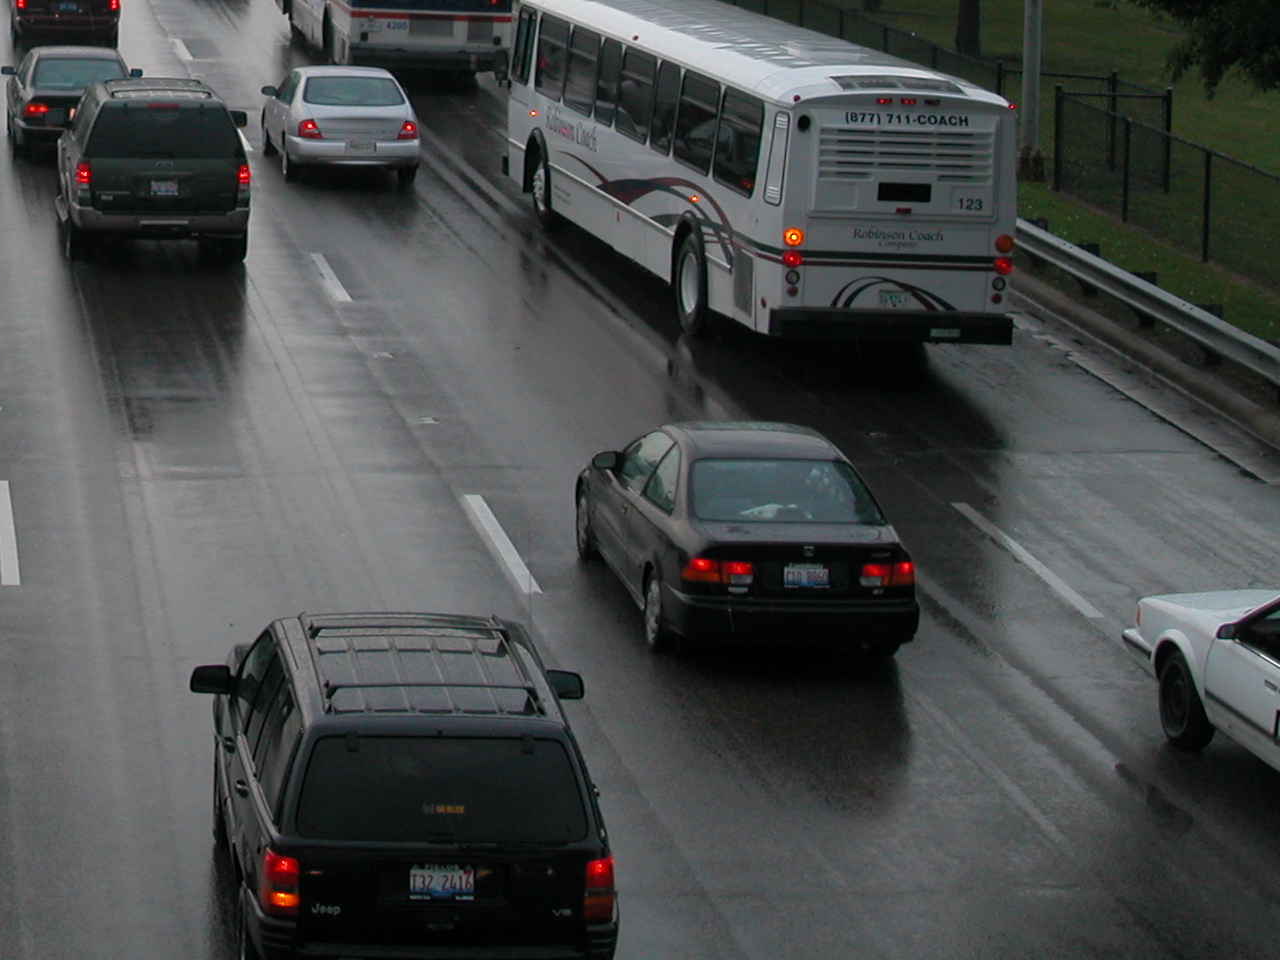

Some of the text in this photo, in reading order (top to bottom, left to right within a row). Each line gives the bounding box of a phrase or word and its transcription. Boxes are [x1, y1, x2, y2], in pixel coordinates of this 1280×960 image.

[386, 21, 408, 30] 4200
[845, 111, 969, 127] (877) 711-COACH
[958, 198, 983, 211] 123
[853, 227, 943, 242] Robinson Coach
[311, 903, 341, 916] Jeep
